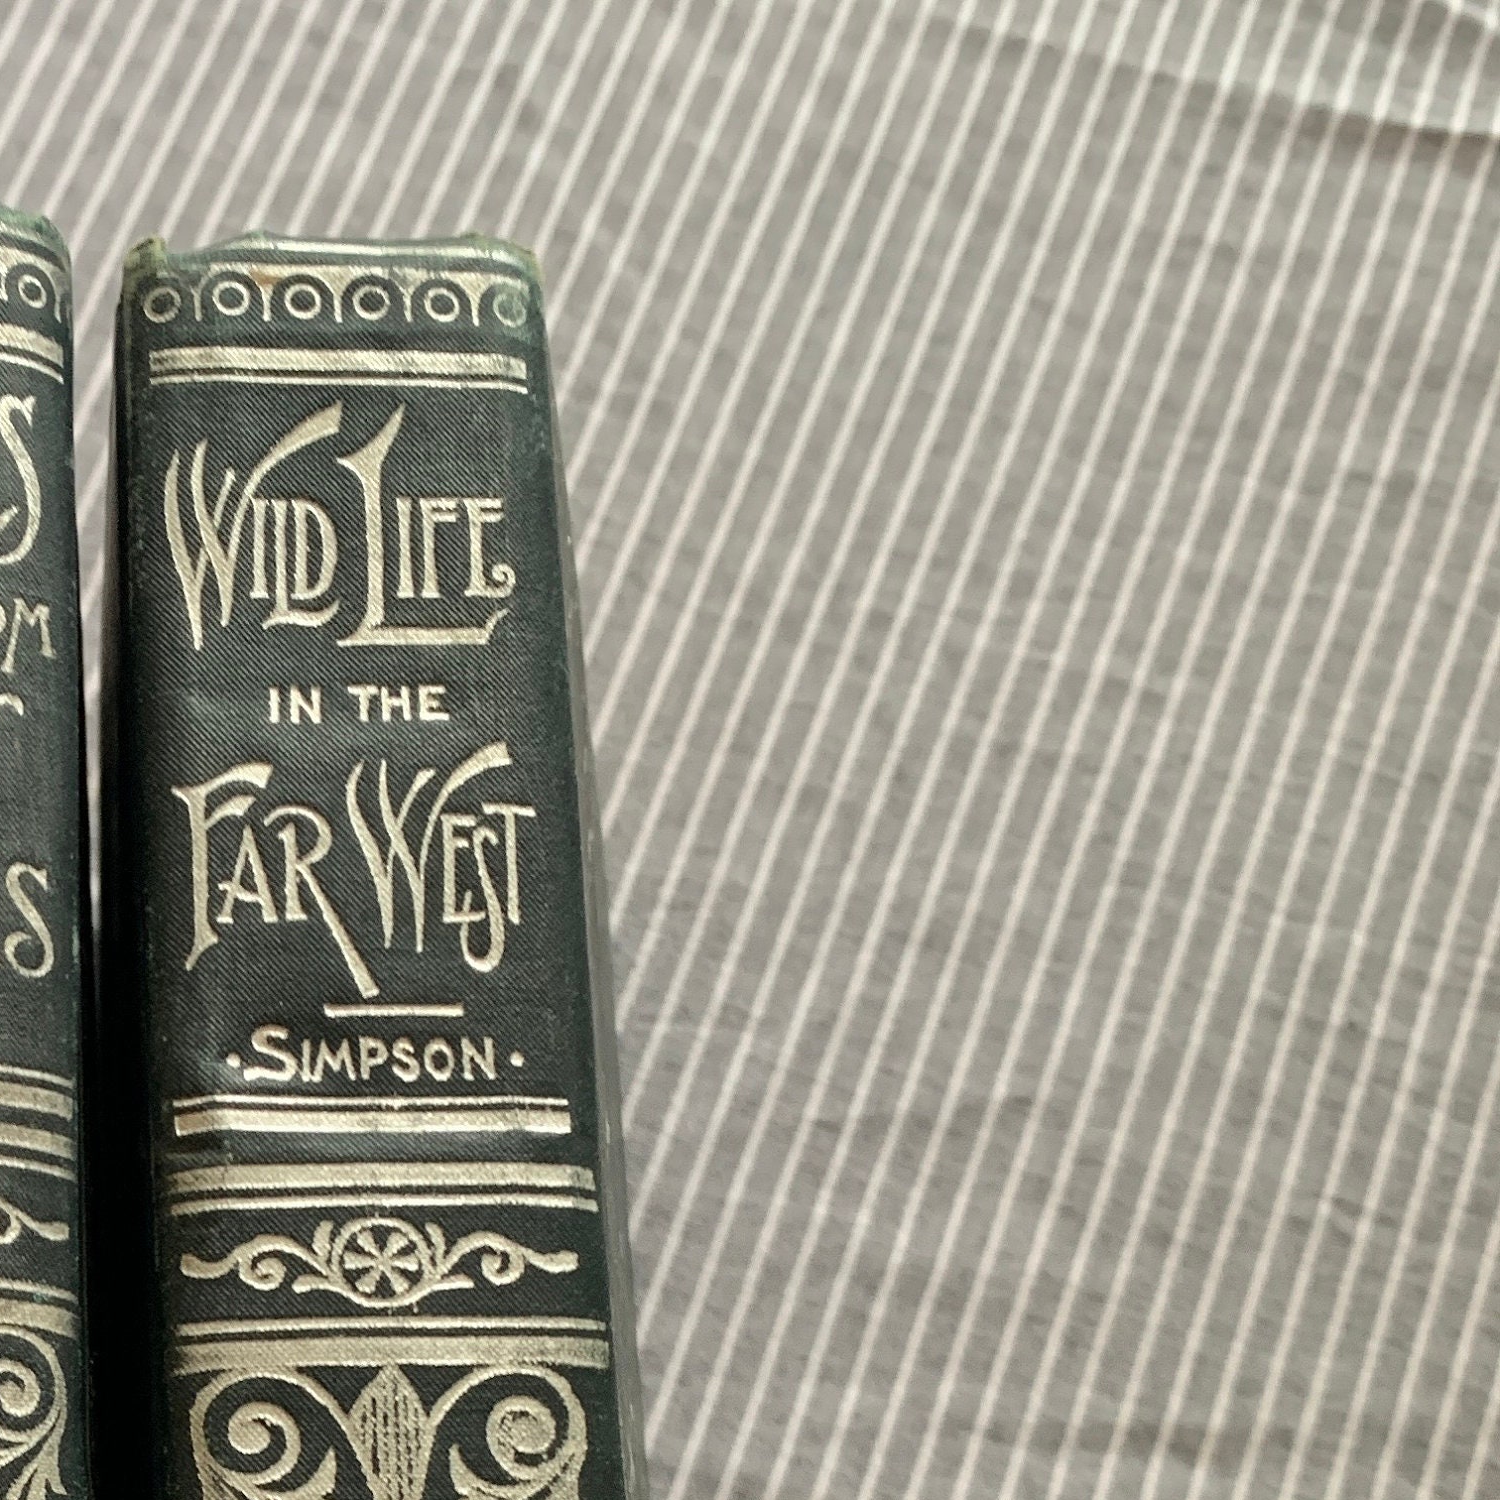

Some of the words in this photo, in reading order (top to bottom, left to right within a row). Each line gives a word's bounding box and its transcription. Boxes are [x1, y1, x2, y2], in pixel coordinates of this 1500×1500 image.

[164, 399, 345, 652] WILD
[336, 401, 517, 648] LIFE
[267, 686, 322, 726] IN
[347, 685, 451, 723] THE
[171, 761, 381, 1000] FAR
[345, 740, 536, 974] WEST
